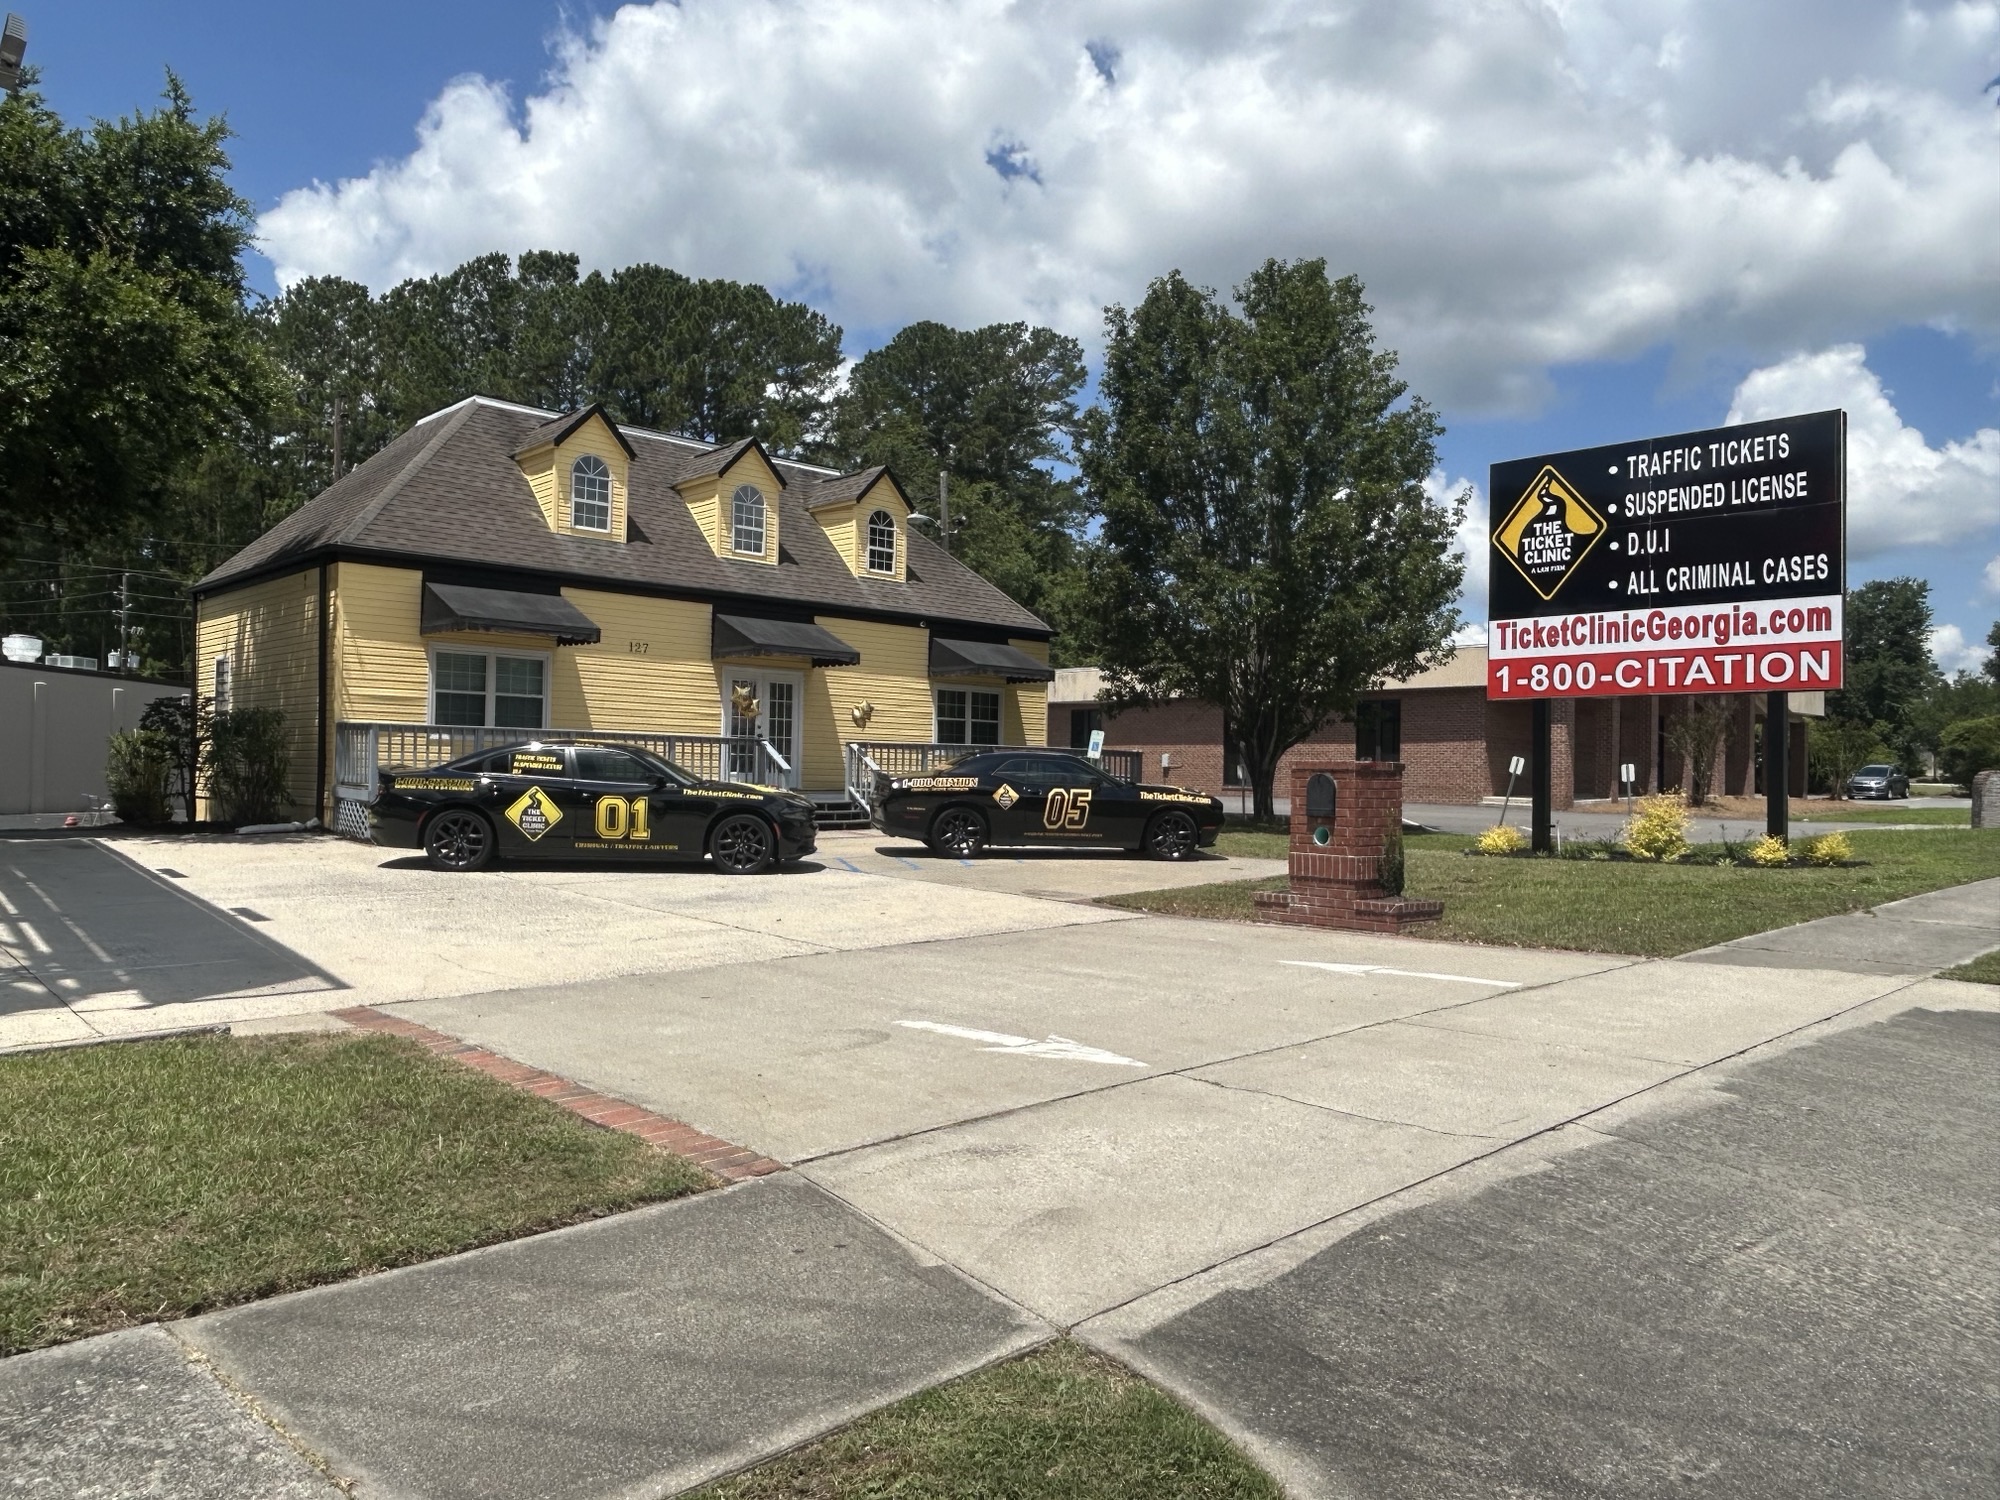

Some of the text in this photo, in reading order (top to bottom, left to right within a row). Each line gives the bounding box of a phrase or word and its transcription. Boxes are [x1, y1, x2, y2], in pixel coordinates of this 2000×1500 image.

[1627, 433, 1790, 479] TRAFFIC TICKETS
[1625, 471, 1808, 517] SUSPENDED LICENSE
[1522, 533, 1574, 551] TICKET
[1533, 521, 1562, 536] THE
[1628, 528, 1670, 556] D.U.I
[1524, 547, 1572, 565] CLINIC
[1627, 553, 1829, 595] ALL CRIMINAL CASES
[630, 642, 649, 653] 127
[1496, 605, 1832, 650] TicketClinicGeorgia.com
[1495, 650, 1830, 693] 1-800-CITATION
[527, 808, 541, 816] THE
[595, 795, 650, 840] 01
[1043, 788, 1092, 829] 05
